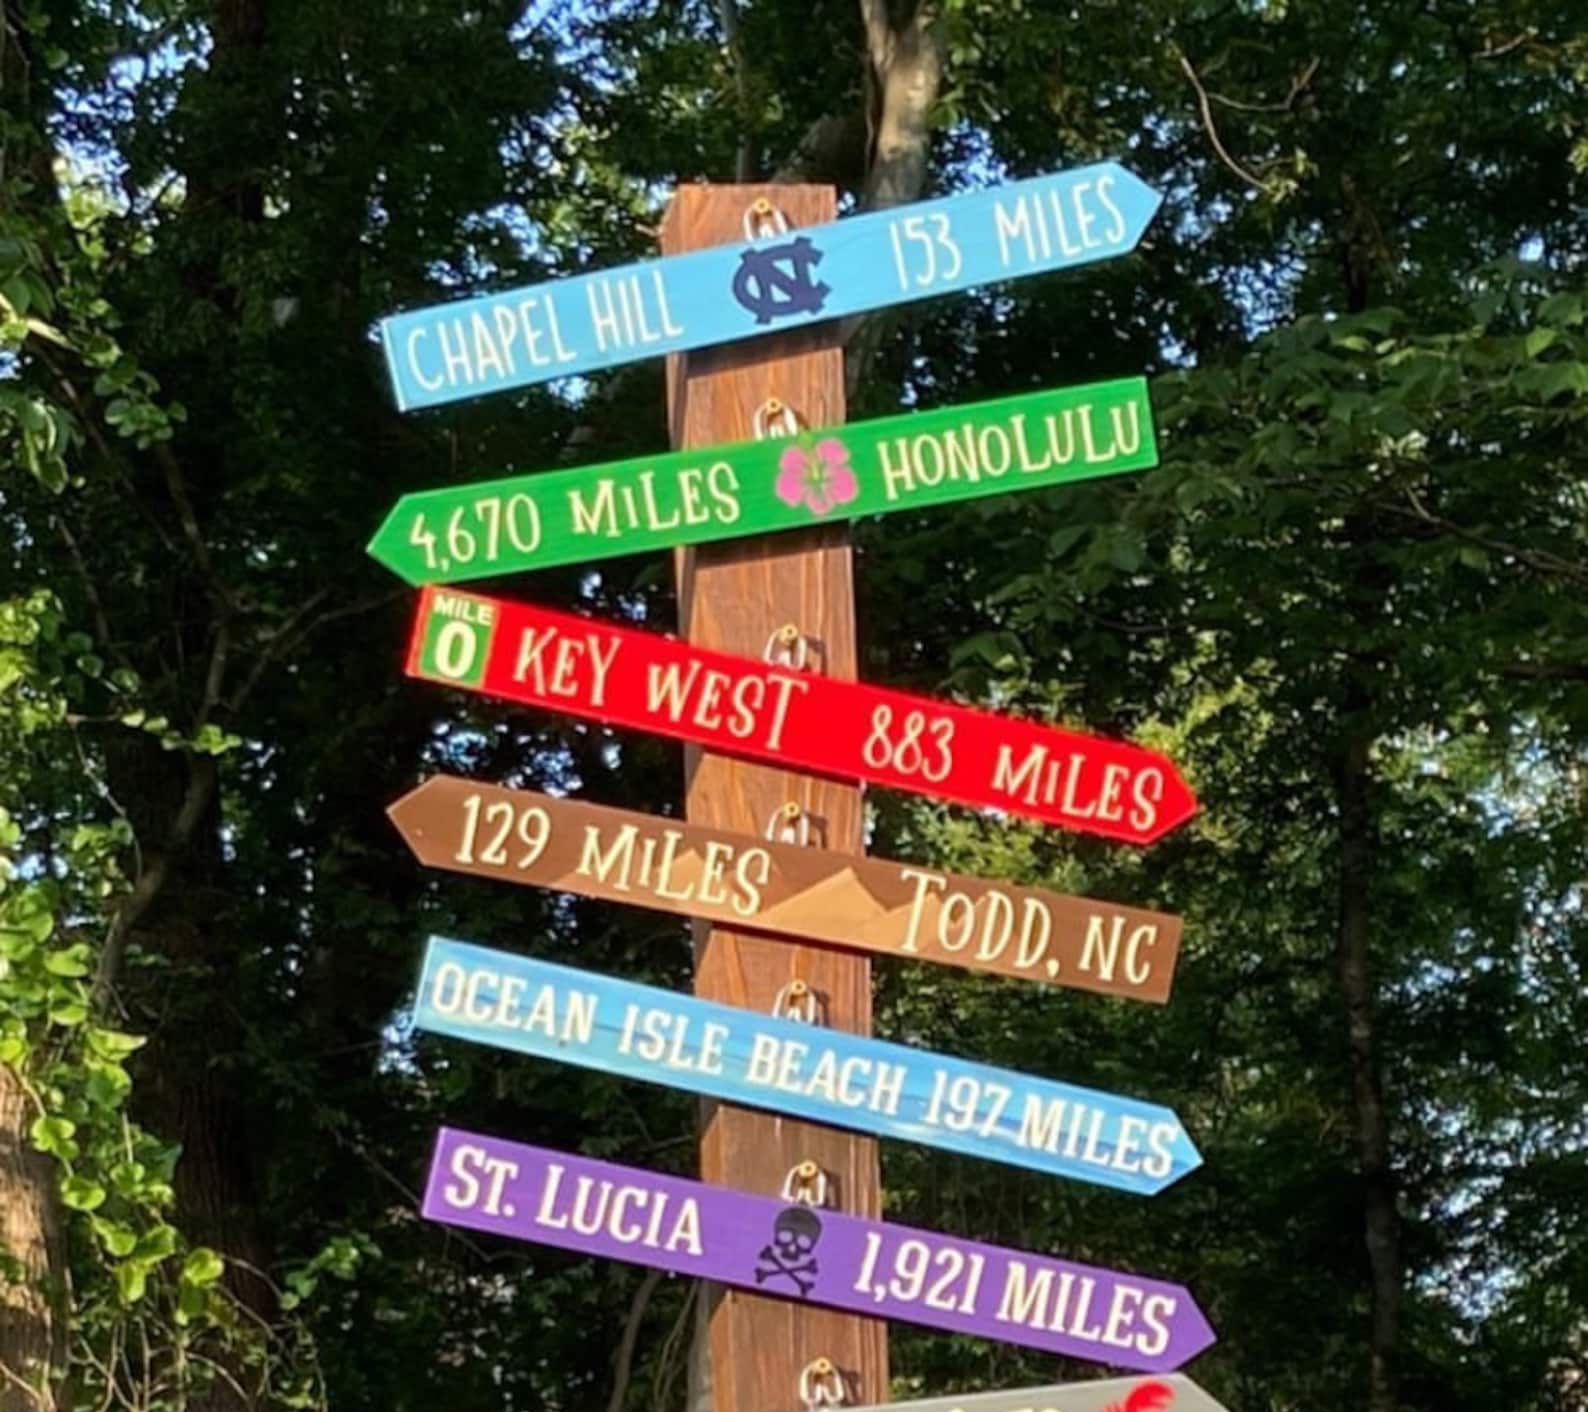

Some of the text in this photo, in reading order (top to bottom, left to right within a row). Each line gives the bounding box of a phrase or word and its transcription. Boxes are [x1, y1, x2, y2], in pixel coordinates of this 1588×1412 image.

[890, 176, 1126, 289] 153 MILES
[407, 270, 684, 391] CHAPEL HILL
[877, 401, 1140, 501] HONOLULU
[409, 494, 540, 573] 4,670
[434, 595, 494, 626] MILE
[435, 621, 476, 678] 0
[513, 626, 621, 707] KEY
[646, 660, 809, 751] WEST
[862, 705, 955, 782] 883
[455, 795, 551, 869] 129
[1078, 914, 1158, 985] NC
[432, 962, 1178, 1178] OCEAN ISLE BEACH 197 MILES
[443, 1144, 703, 1255] ST. LUCIA
[854, 1231, 1177, 1356] 1,921 MILES
